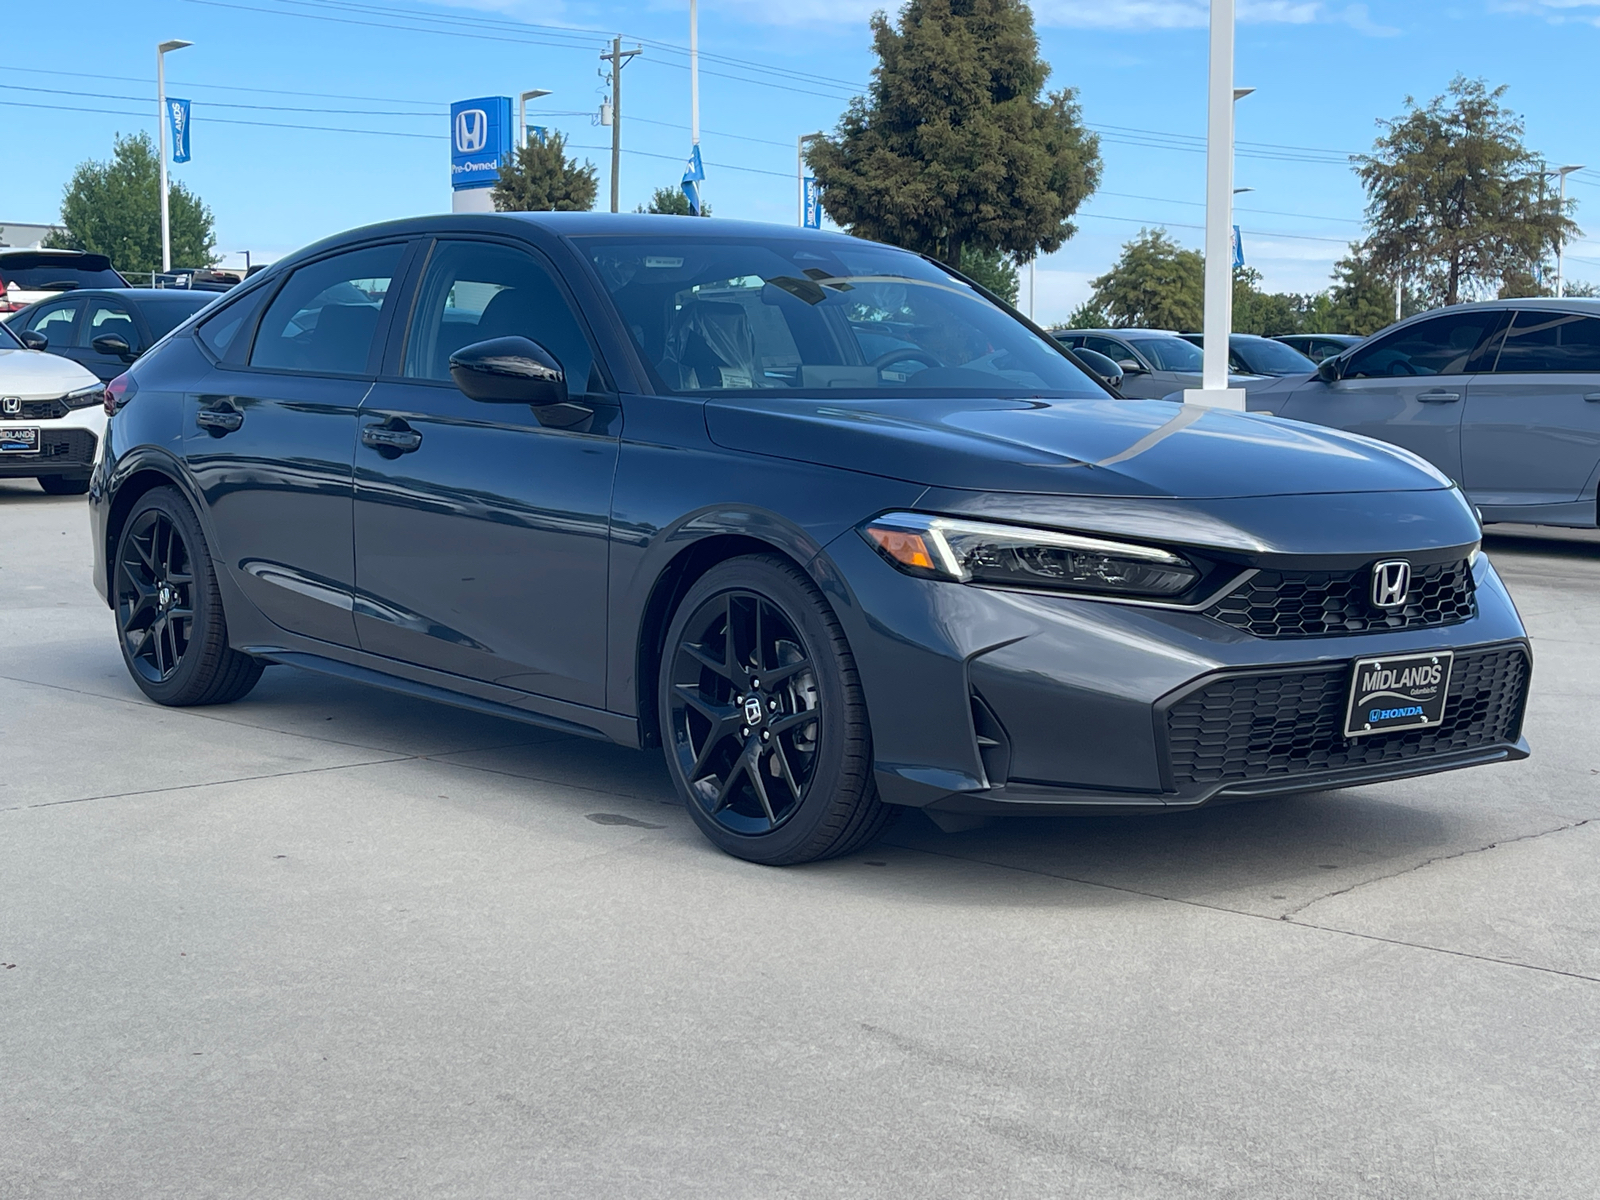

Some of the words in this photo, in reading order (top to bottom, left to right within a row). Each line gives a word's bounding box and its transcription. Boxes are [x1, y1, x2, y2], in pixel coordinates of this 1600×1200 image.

[451, 159, 497, 174] Pre-Owned
[1362, 665, 1442, 691] MIDLANDS
[1380, 706, 1423, 719] HONDA
